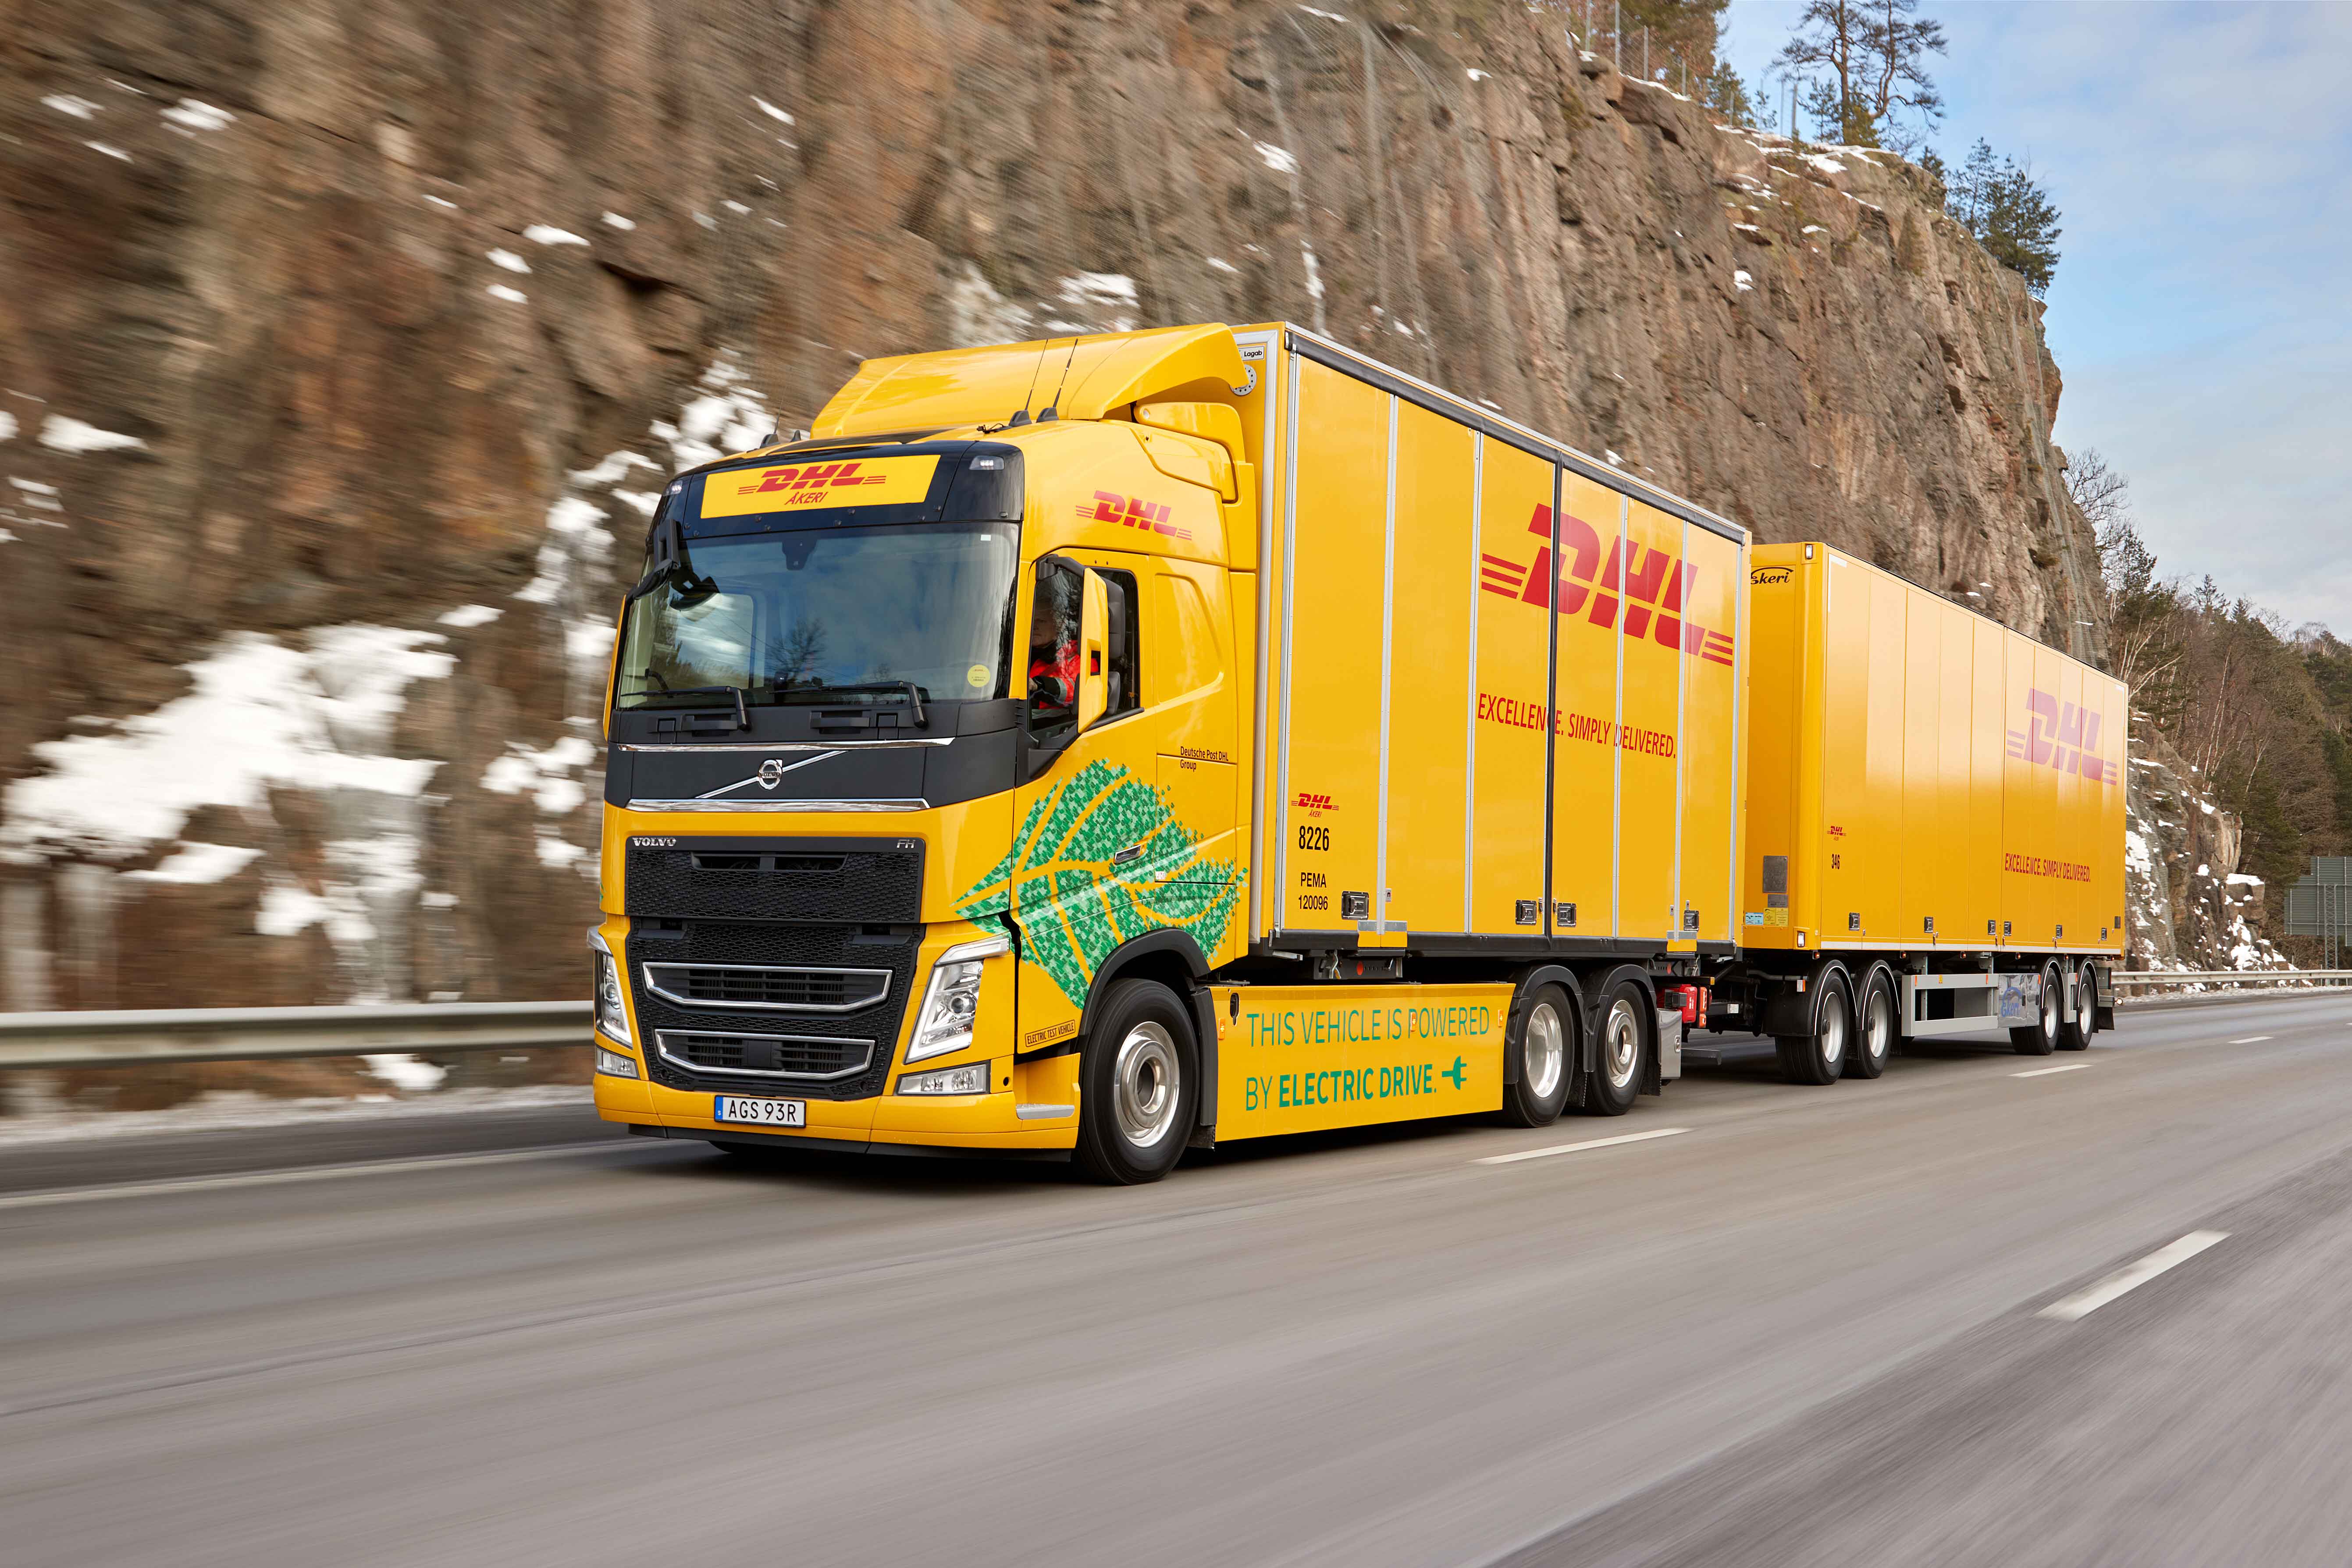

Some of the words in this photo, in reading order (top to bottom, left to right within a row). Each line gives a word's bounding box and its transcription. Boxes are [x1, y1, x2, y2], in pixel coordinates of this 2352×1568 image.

[756, 463, 865, 493] DHL
[784, 491, 829, 505] ÅKERI
[1093, 490, 1178, 537] DHL
[1521, 502, 1705, 656] DHL
[1477, 693, 1564, 736] EXCELLENE.
[1568, 713, 1611, 745] SIMPLY
[1613, 723, 1676, 758] DELIVERED.
[2023, 687, 2104, 781] DHL
[1180, 746, 1205, 758] Deutsche
[1206, 749, 1218, 760] Post
[1219, 751, 1229, 761] DHL
[1180, 759, 1196, 772] Group
[1298, 793, 1333, 810] DHL
[632, 837, 676, 846] VOLVO
[1299, 825, 1330, 851] 8226
[1830, 825, 1843, 836] DHL
[897, 839, 916, 849] FH
[1832, 853, 1840, 870] 346
[2005, 853, 2042, 876] EXCELLENCE.
[2042, 859, 2063, 878] SIMPLY
[2063, 862, 2091, 883] DELIVERED.
[1301, 872, 1327, 888] PEMA
[1299, 895, 1328, 910] 120096
[1027, 1030, 1046, 1044] ELECTRIC
[1047, 1028, 1057, 1038] TEST
[1057, 1022, 1074, 1035] VEHICLE
[1246, 1011, 1295, 1047] THIS
[1301, 1009, 1381, 1044] VEHICLE
[1387, 1008, 1402, 1040] IS
[1408, 1006, 1490, 1039] POWERED
[1246, 1075, 1273, 1111] BY
[1278, 1067, 1374, 1108] ELECTRIC
[1379, 1063, 1437, 1098] DRIVE.
[729, 1099, 759, 1119] AGS
[764, 1102, 796, 1122] 93R
